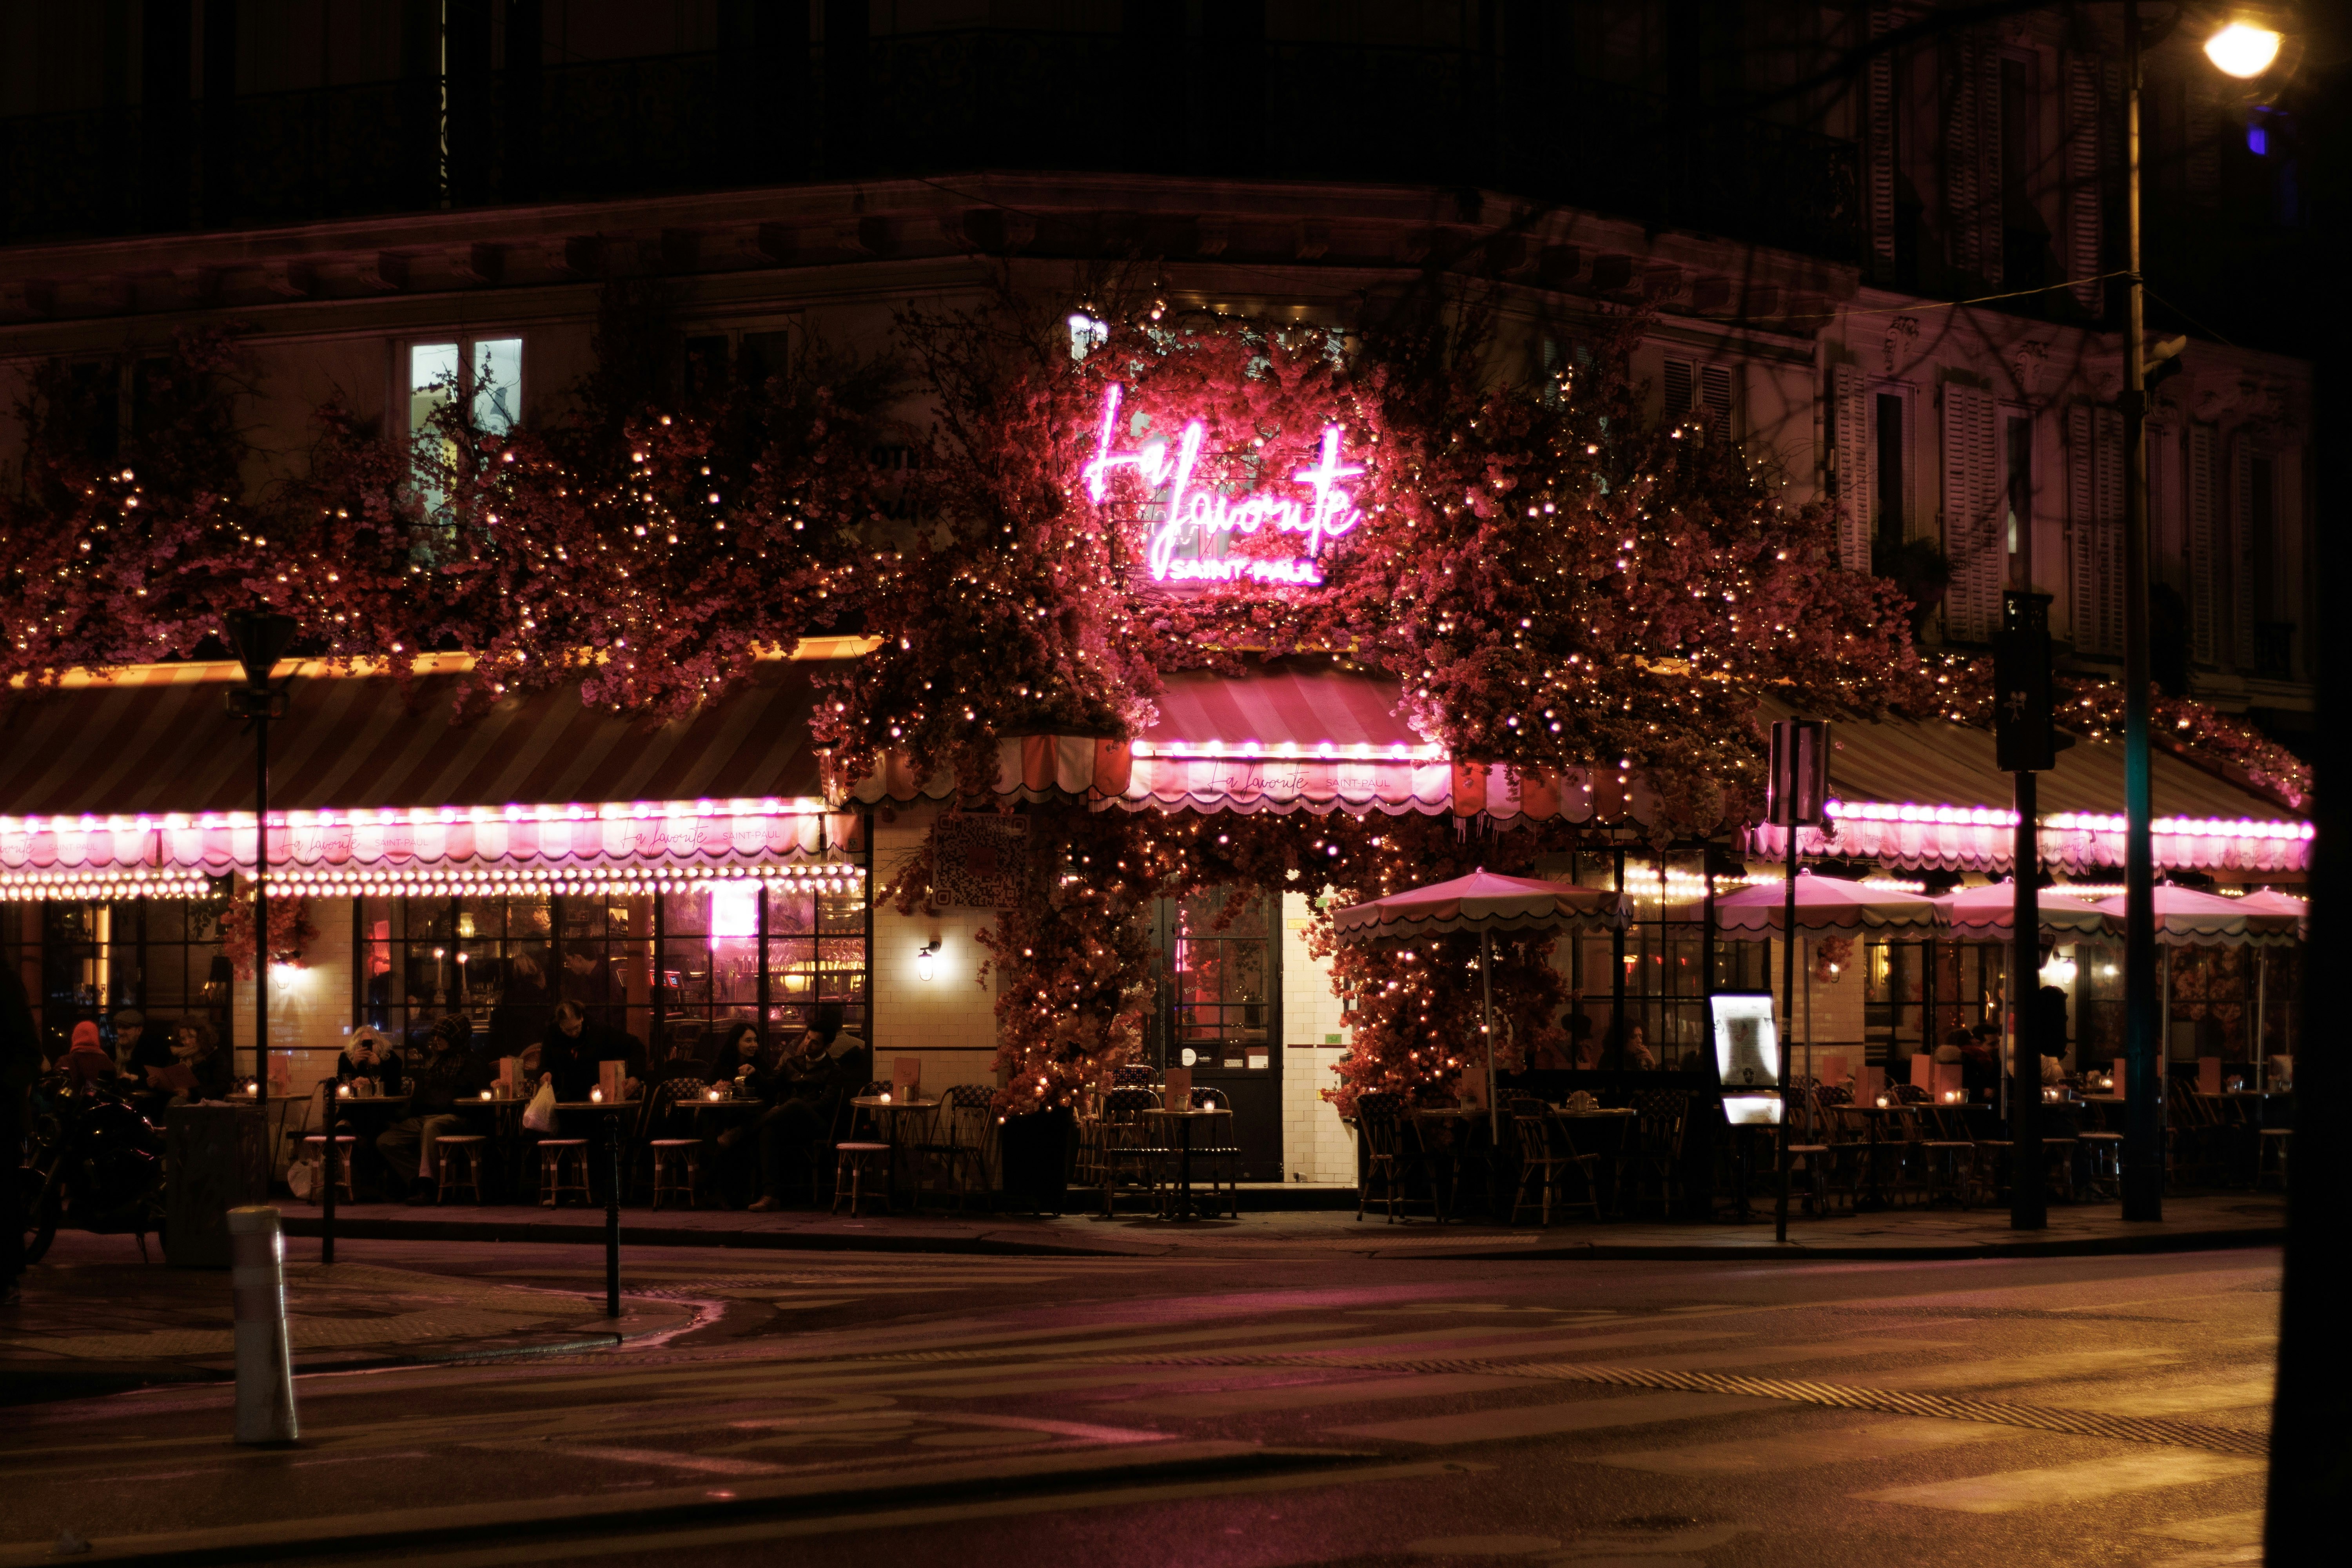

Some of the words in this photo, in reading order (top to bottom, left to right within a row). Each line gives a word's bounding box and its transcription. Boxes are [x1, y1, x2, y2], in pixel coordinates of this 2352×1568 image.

[1169, 558, 1321, 584] SAINT-PAUL
[1207, 760, 1238, 793] La
[1326, 779, 1391, 787] SAINT-PAUL
[48, 843, 97, 852] SAINT-PAUL
[278, 826, 303, 856] La
[375, 838, 429, 848] SAINT-PAUL
[620, 817, 646, 849] La
[722, 830, 780, 840] SAINT-PAUL
